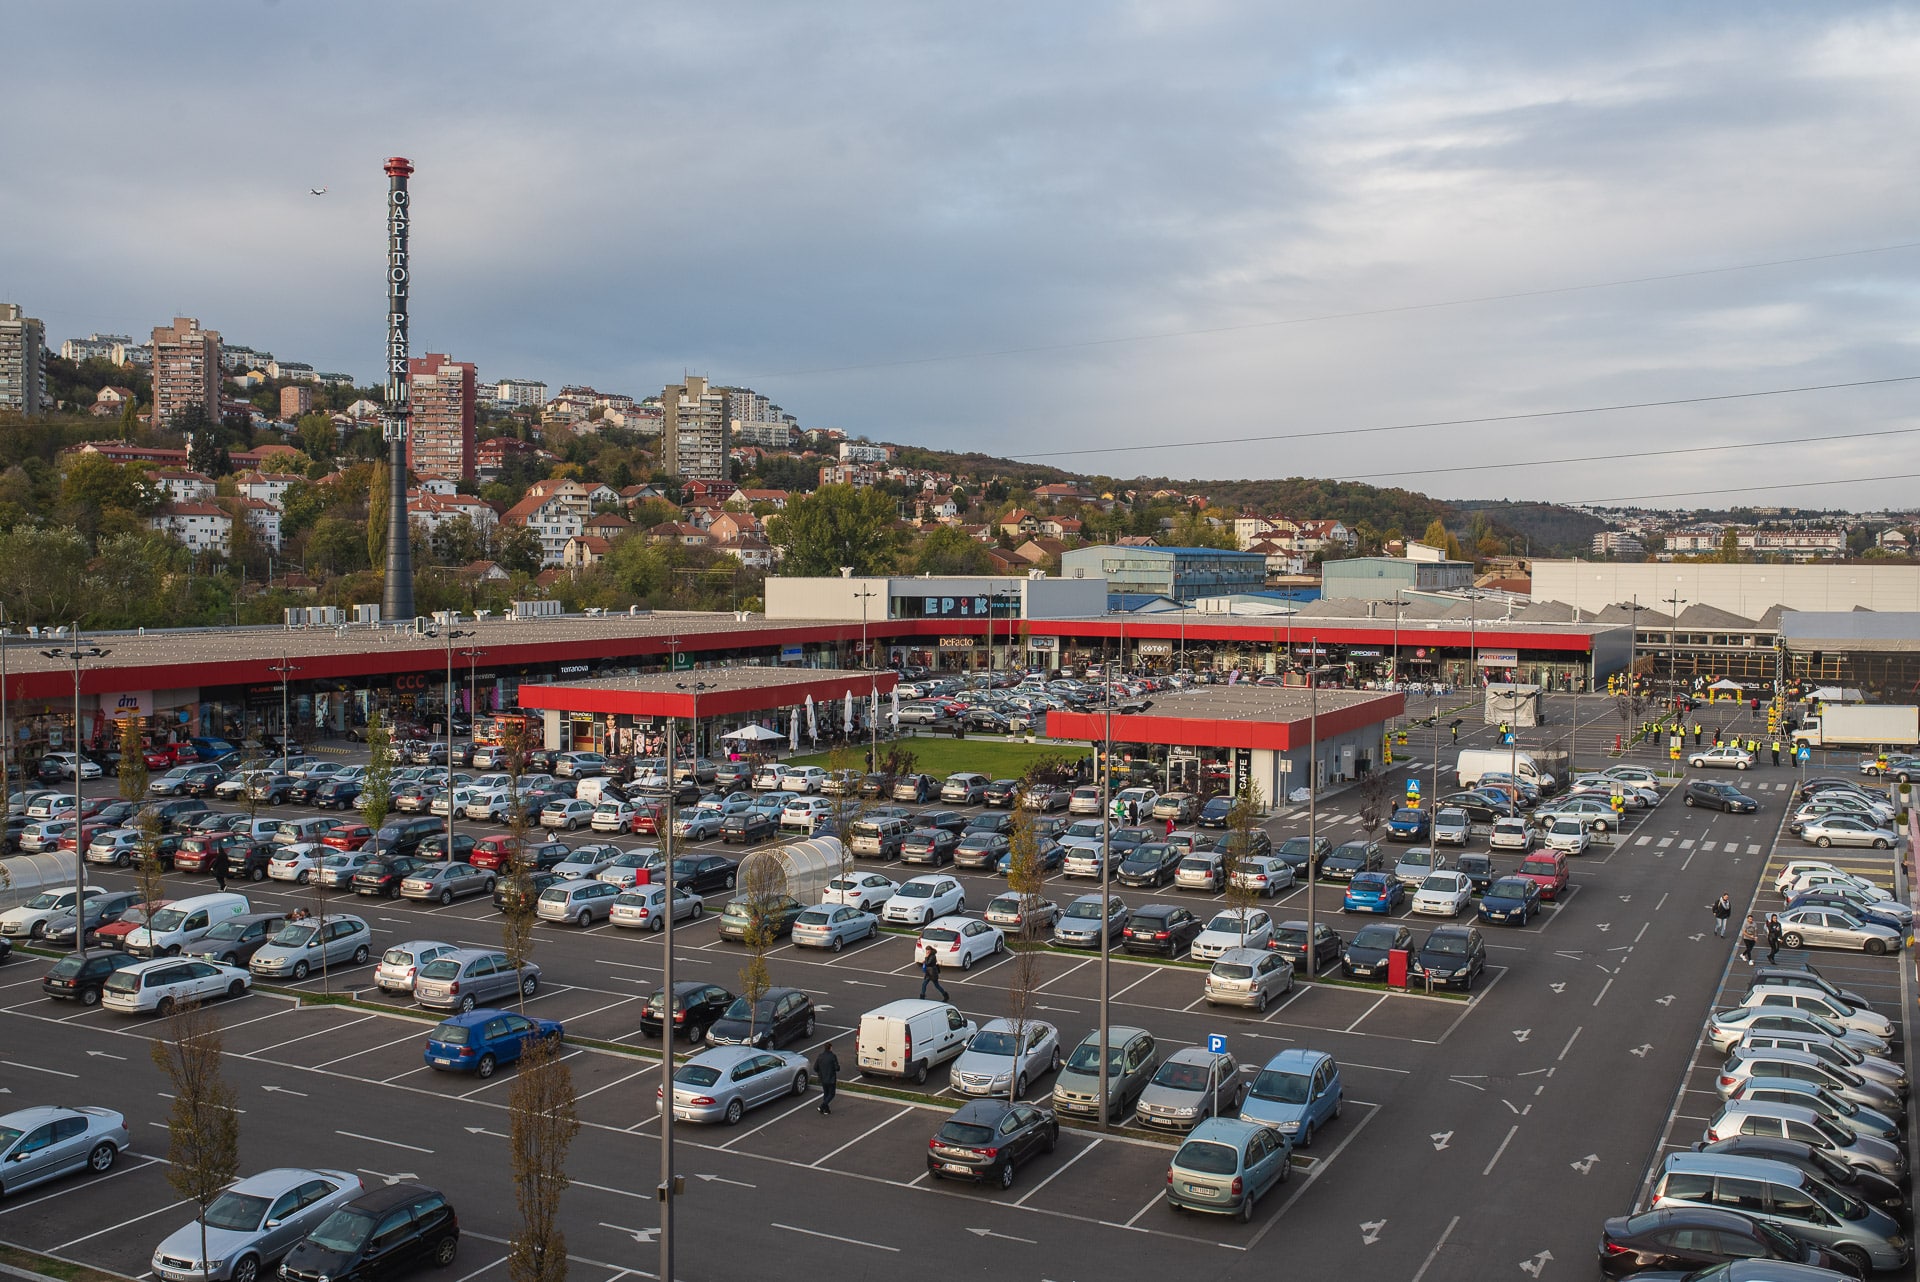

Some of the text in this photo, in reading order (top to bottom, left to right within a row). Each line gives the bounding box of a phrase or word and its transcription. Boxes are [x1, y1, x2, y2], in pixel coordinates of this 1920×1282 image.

[391, 191, 407, 373] CAPITOL PARK
[940, 638, 974, 647] DeFacto
[678, 652, 686, 664] D
[397, 674, 425, 690] CCC
[464, 673, 496, 681] exremeintimo
[118, 694, 137, 707] dm
[1239, 759, 1248, 790] CAFFE
[1212, 1037, 1222, 1051] P
